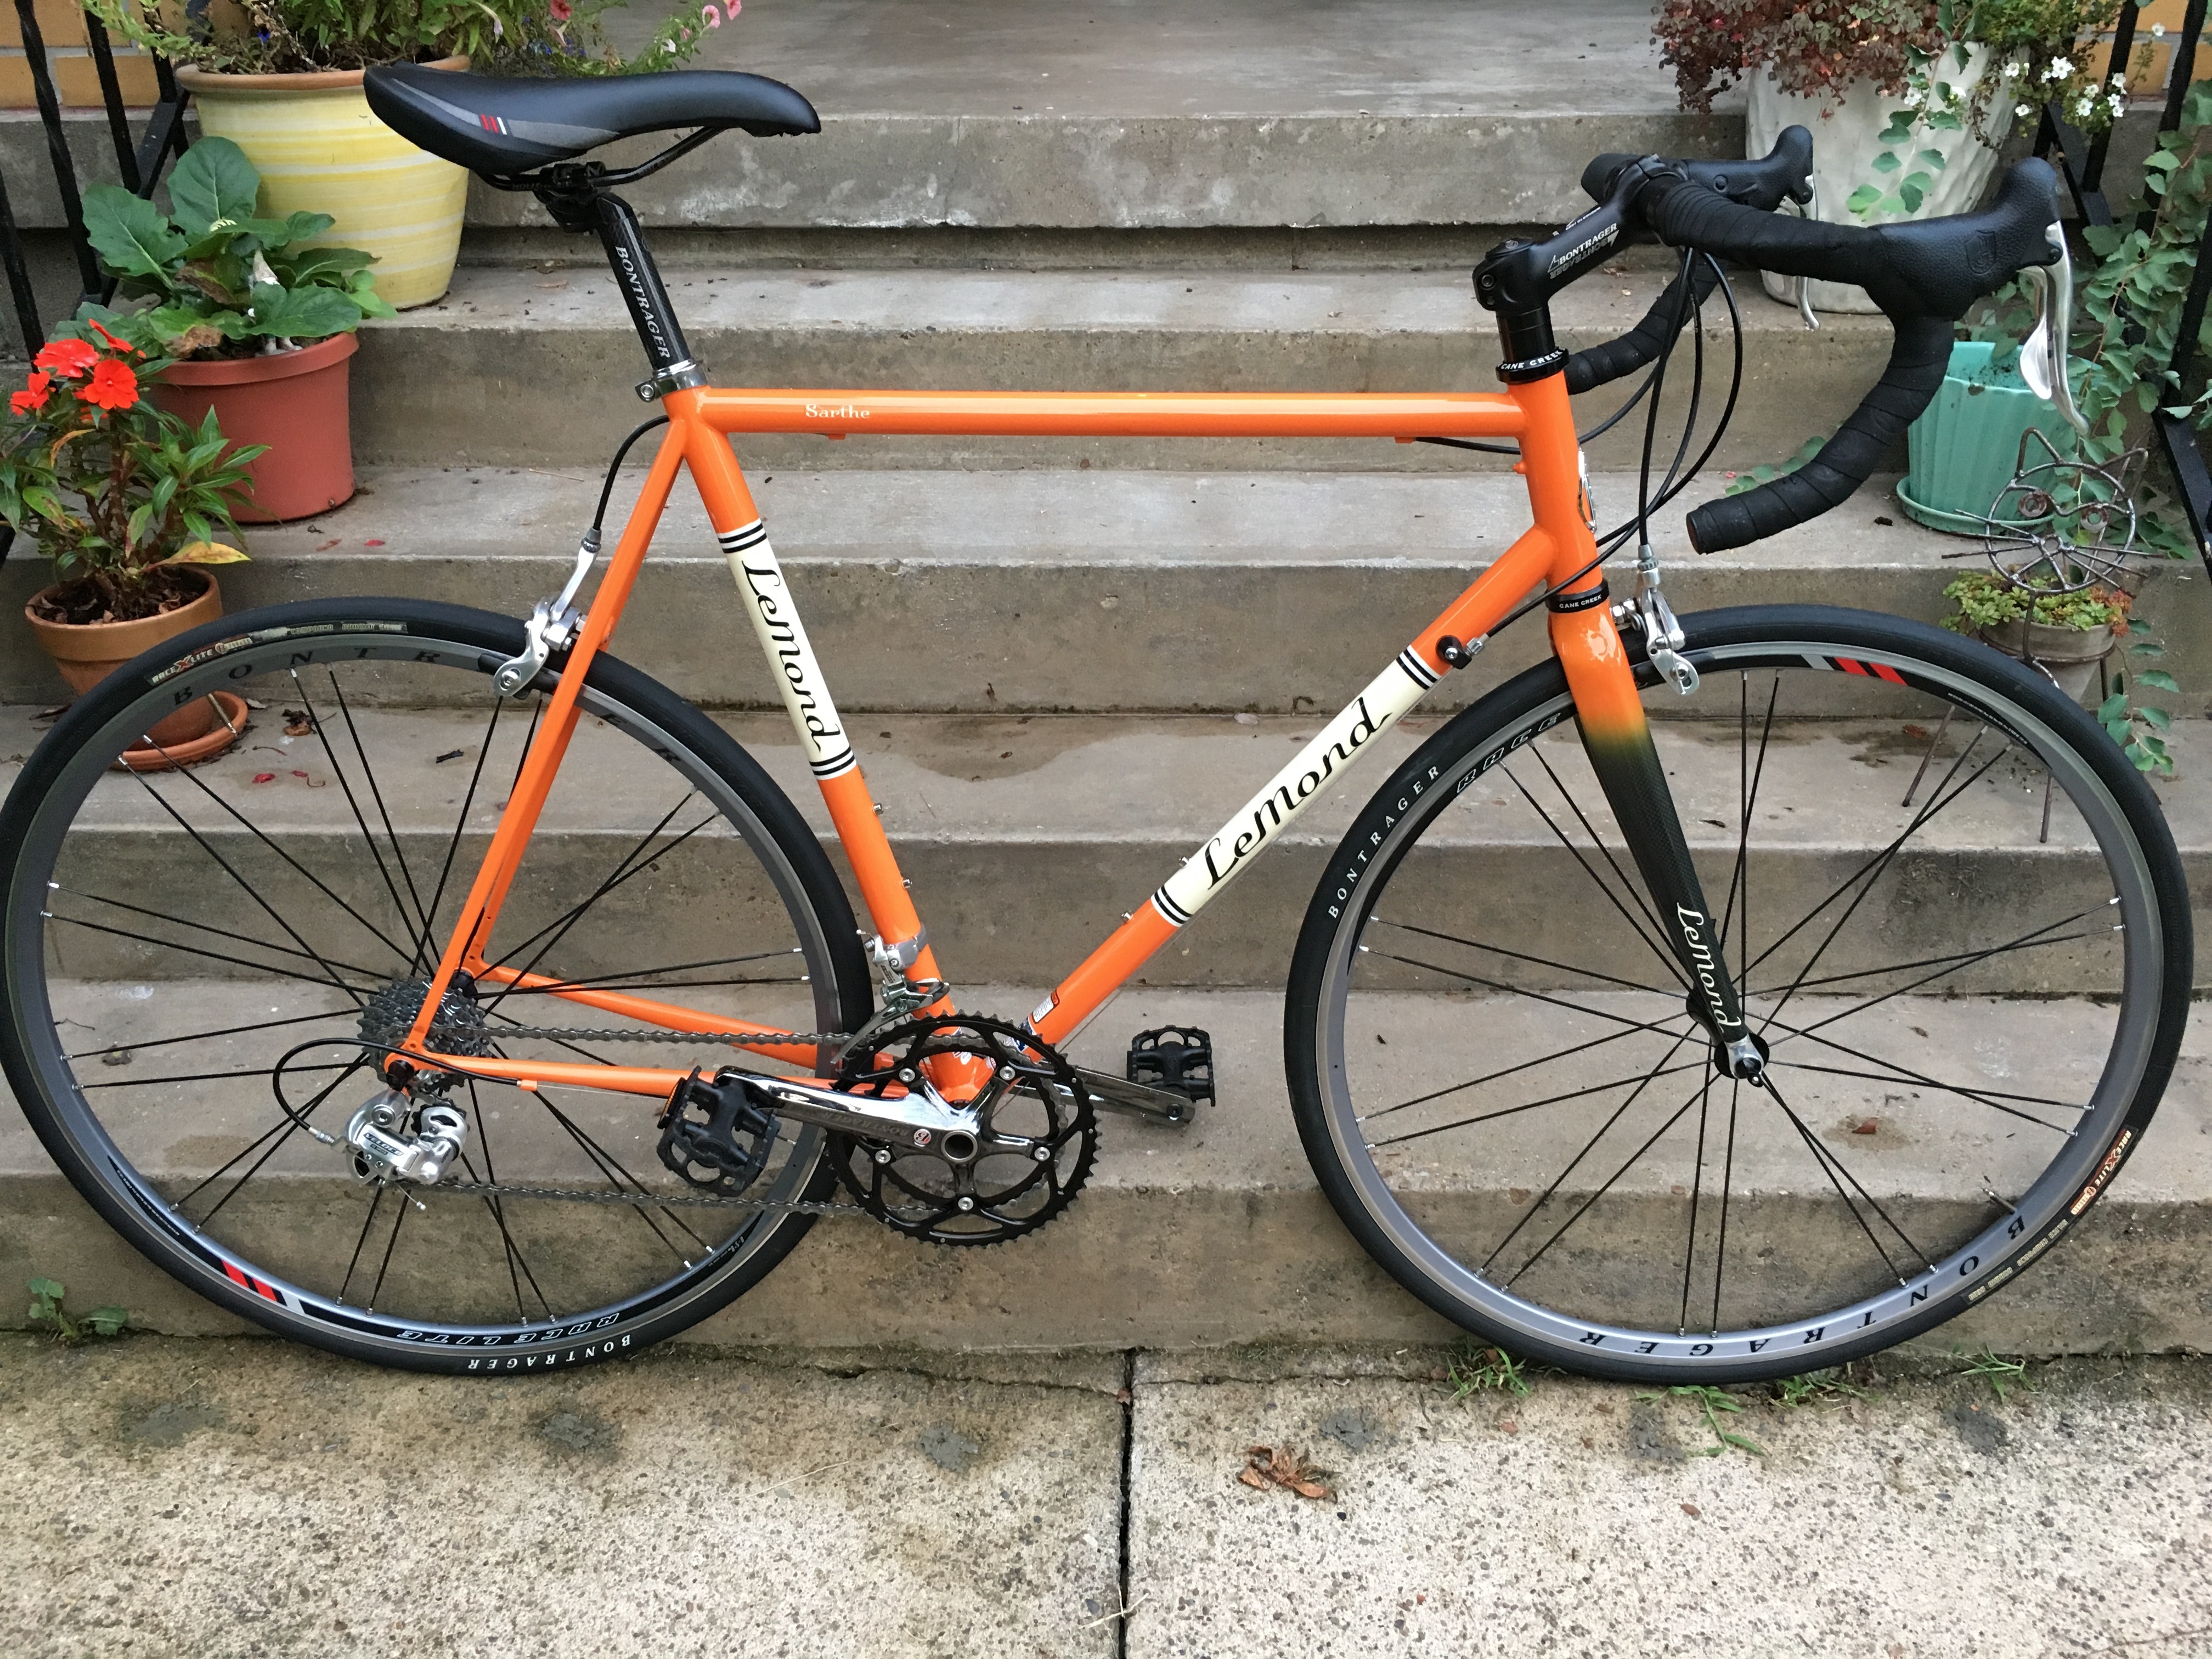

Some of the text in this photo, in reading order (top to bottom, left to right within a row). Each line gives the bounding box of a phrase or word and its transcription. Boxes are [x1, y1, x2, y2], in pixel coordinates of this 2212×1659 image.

[1549, 236, 1608, 279] BONTRAGER
[1559, 223, 1617, 266] BONTRAGER
[615, 246, 670, 358] BONTRAGER
[1529, 350, 1563, 366] CREEK
[805, 403, 870, 419] Sarthe
[1581, 594, 1602, 606] CREEK
[1457, 712, 1562, 794] RACE
[1328, 765, 1440, 919] BONTRAGER
[824, 1111, 910, 1137] BONTRAGER
[364, 1132, 404, 1156] VELOCE
[1578, 1215, 2025, 1357] BONTRAGER
[397, 1313, 619, 1345] RACE LITE
[468, 1334, 631, 1370] BONTRAGER
